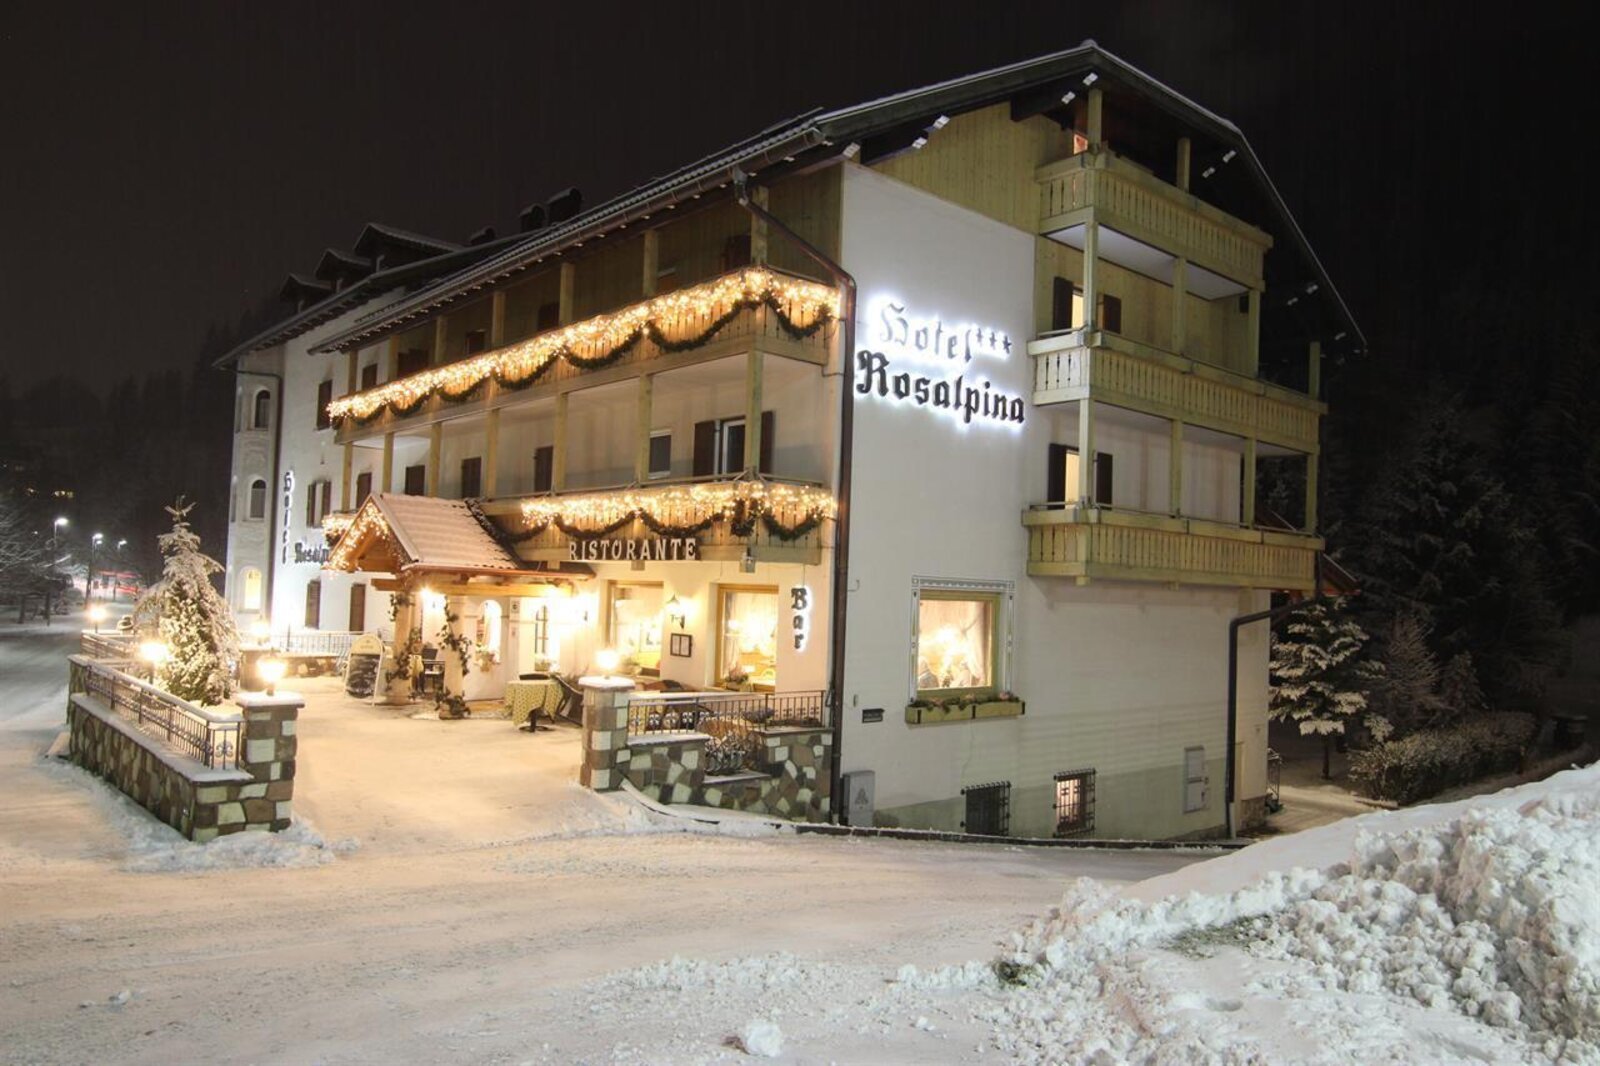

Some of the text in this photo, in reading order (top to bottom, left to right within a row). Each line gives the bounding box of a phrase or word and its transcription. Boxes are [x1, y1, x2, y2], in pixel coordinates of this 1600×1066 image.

[856, 349, 1025, 424] Rosalpina
[569, 537, 697, 561] RISTORANTE
[790, 587, 808, 650] Bar
